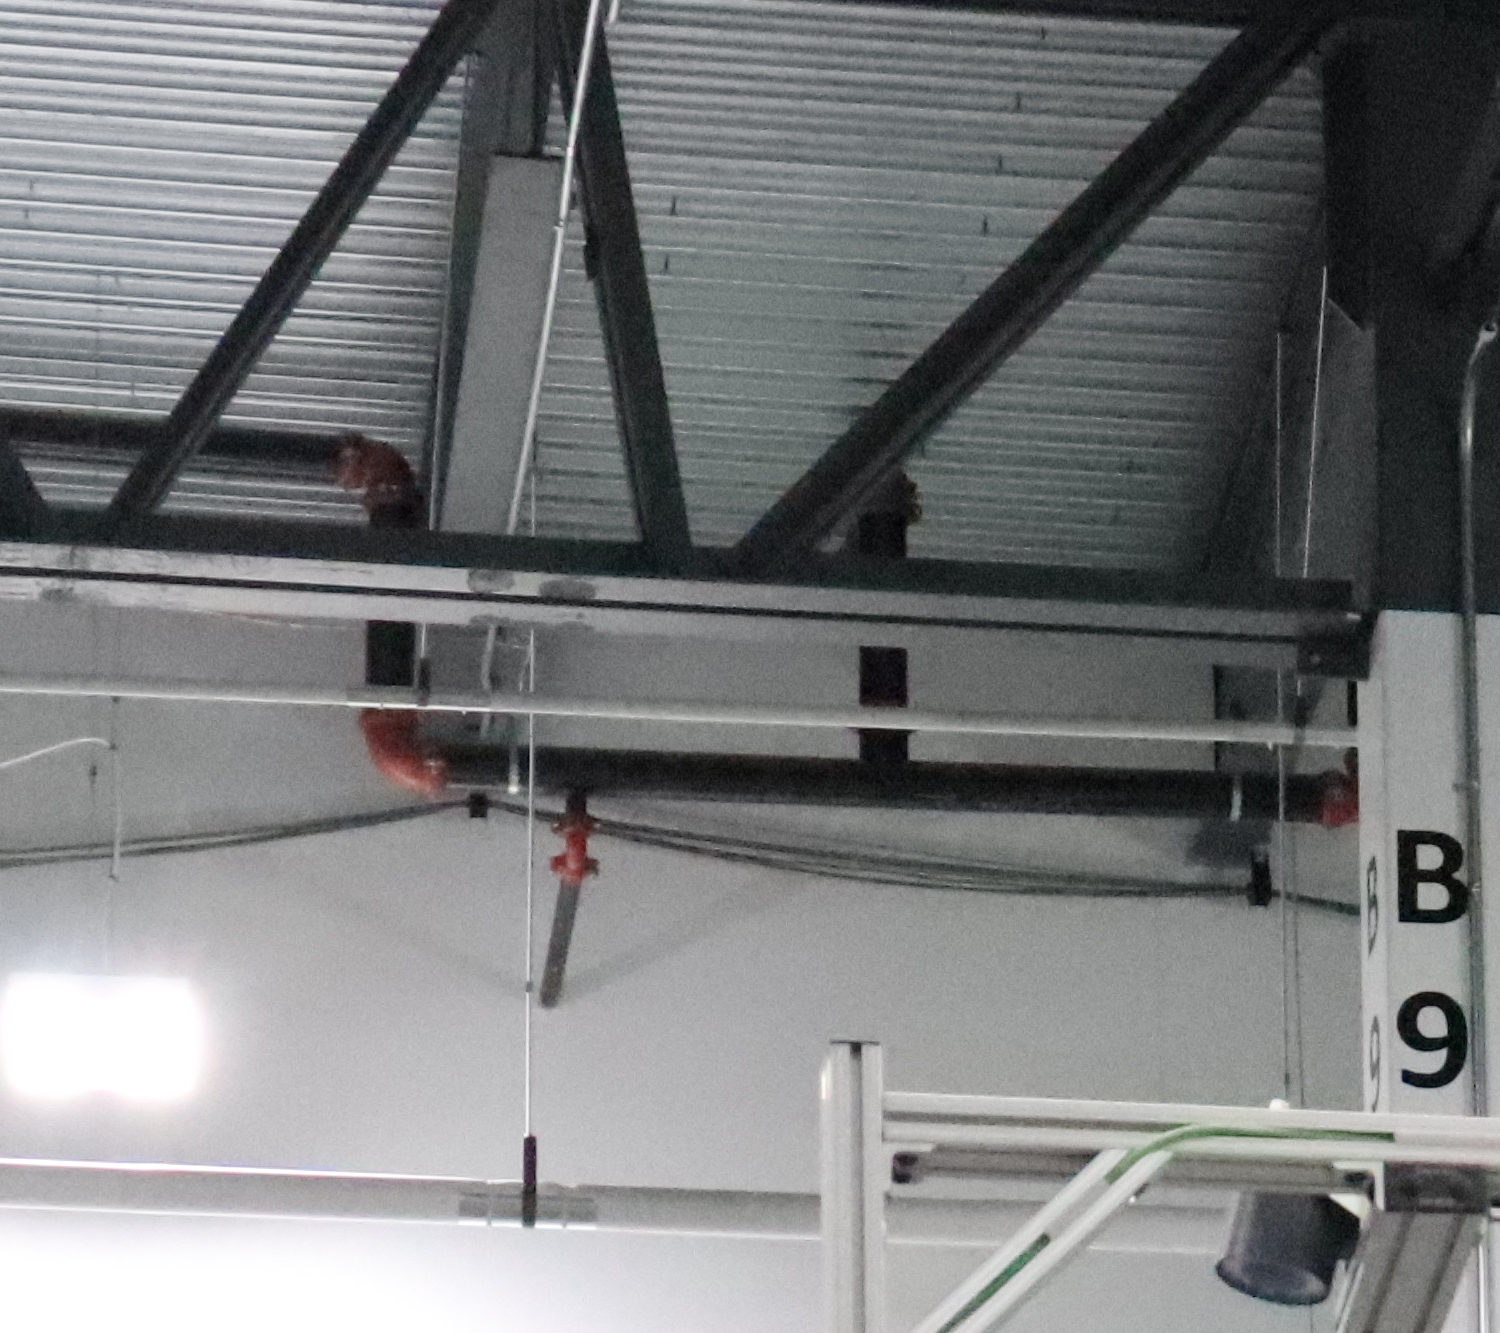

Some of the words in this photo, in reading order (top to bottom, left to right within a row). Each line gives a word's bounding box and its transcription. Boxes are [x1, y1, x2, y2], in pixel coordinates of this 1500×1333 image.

[1367, 855, 1379, 957] B
[1397, 830, 1470, 923] B
[1397, 991, 1469, 1088] 9
